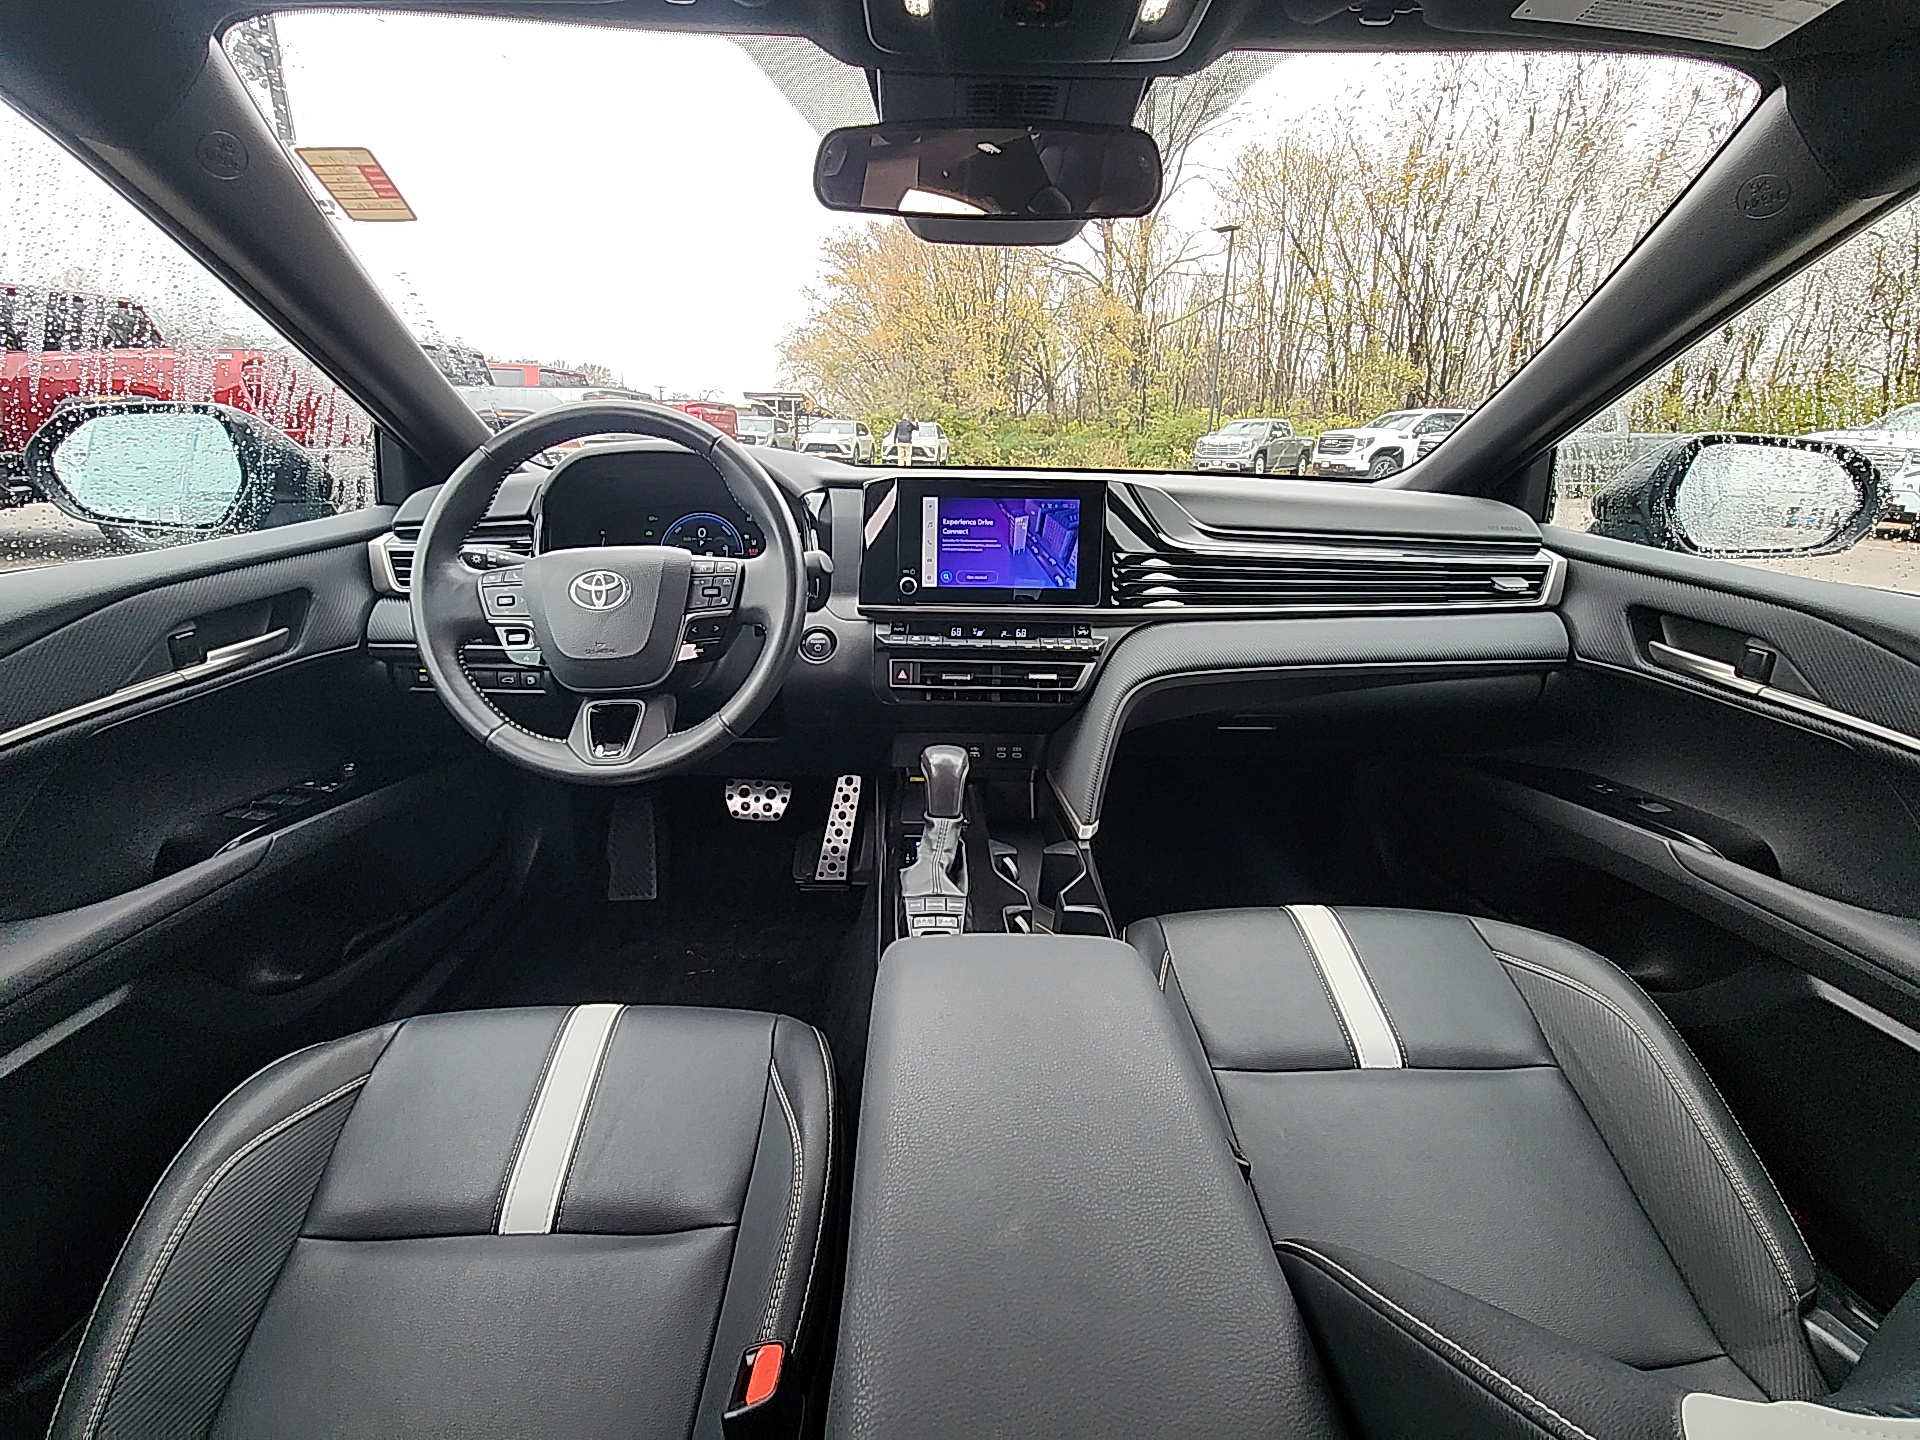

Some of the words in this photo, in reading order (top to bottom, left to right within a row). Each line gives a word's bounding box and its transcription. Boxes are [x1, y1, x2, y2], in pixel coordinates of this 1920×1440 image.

[942, 518, 977, 527] Experience
[978, 518, 994, 526] Drive
[950, 627, 962, 637] 68
[1015, 628, 1027, 638] 68
